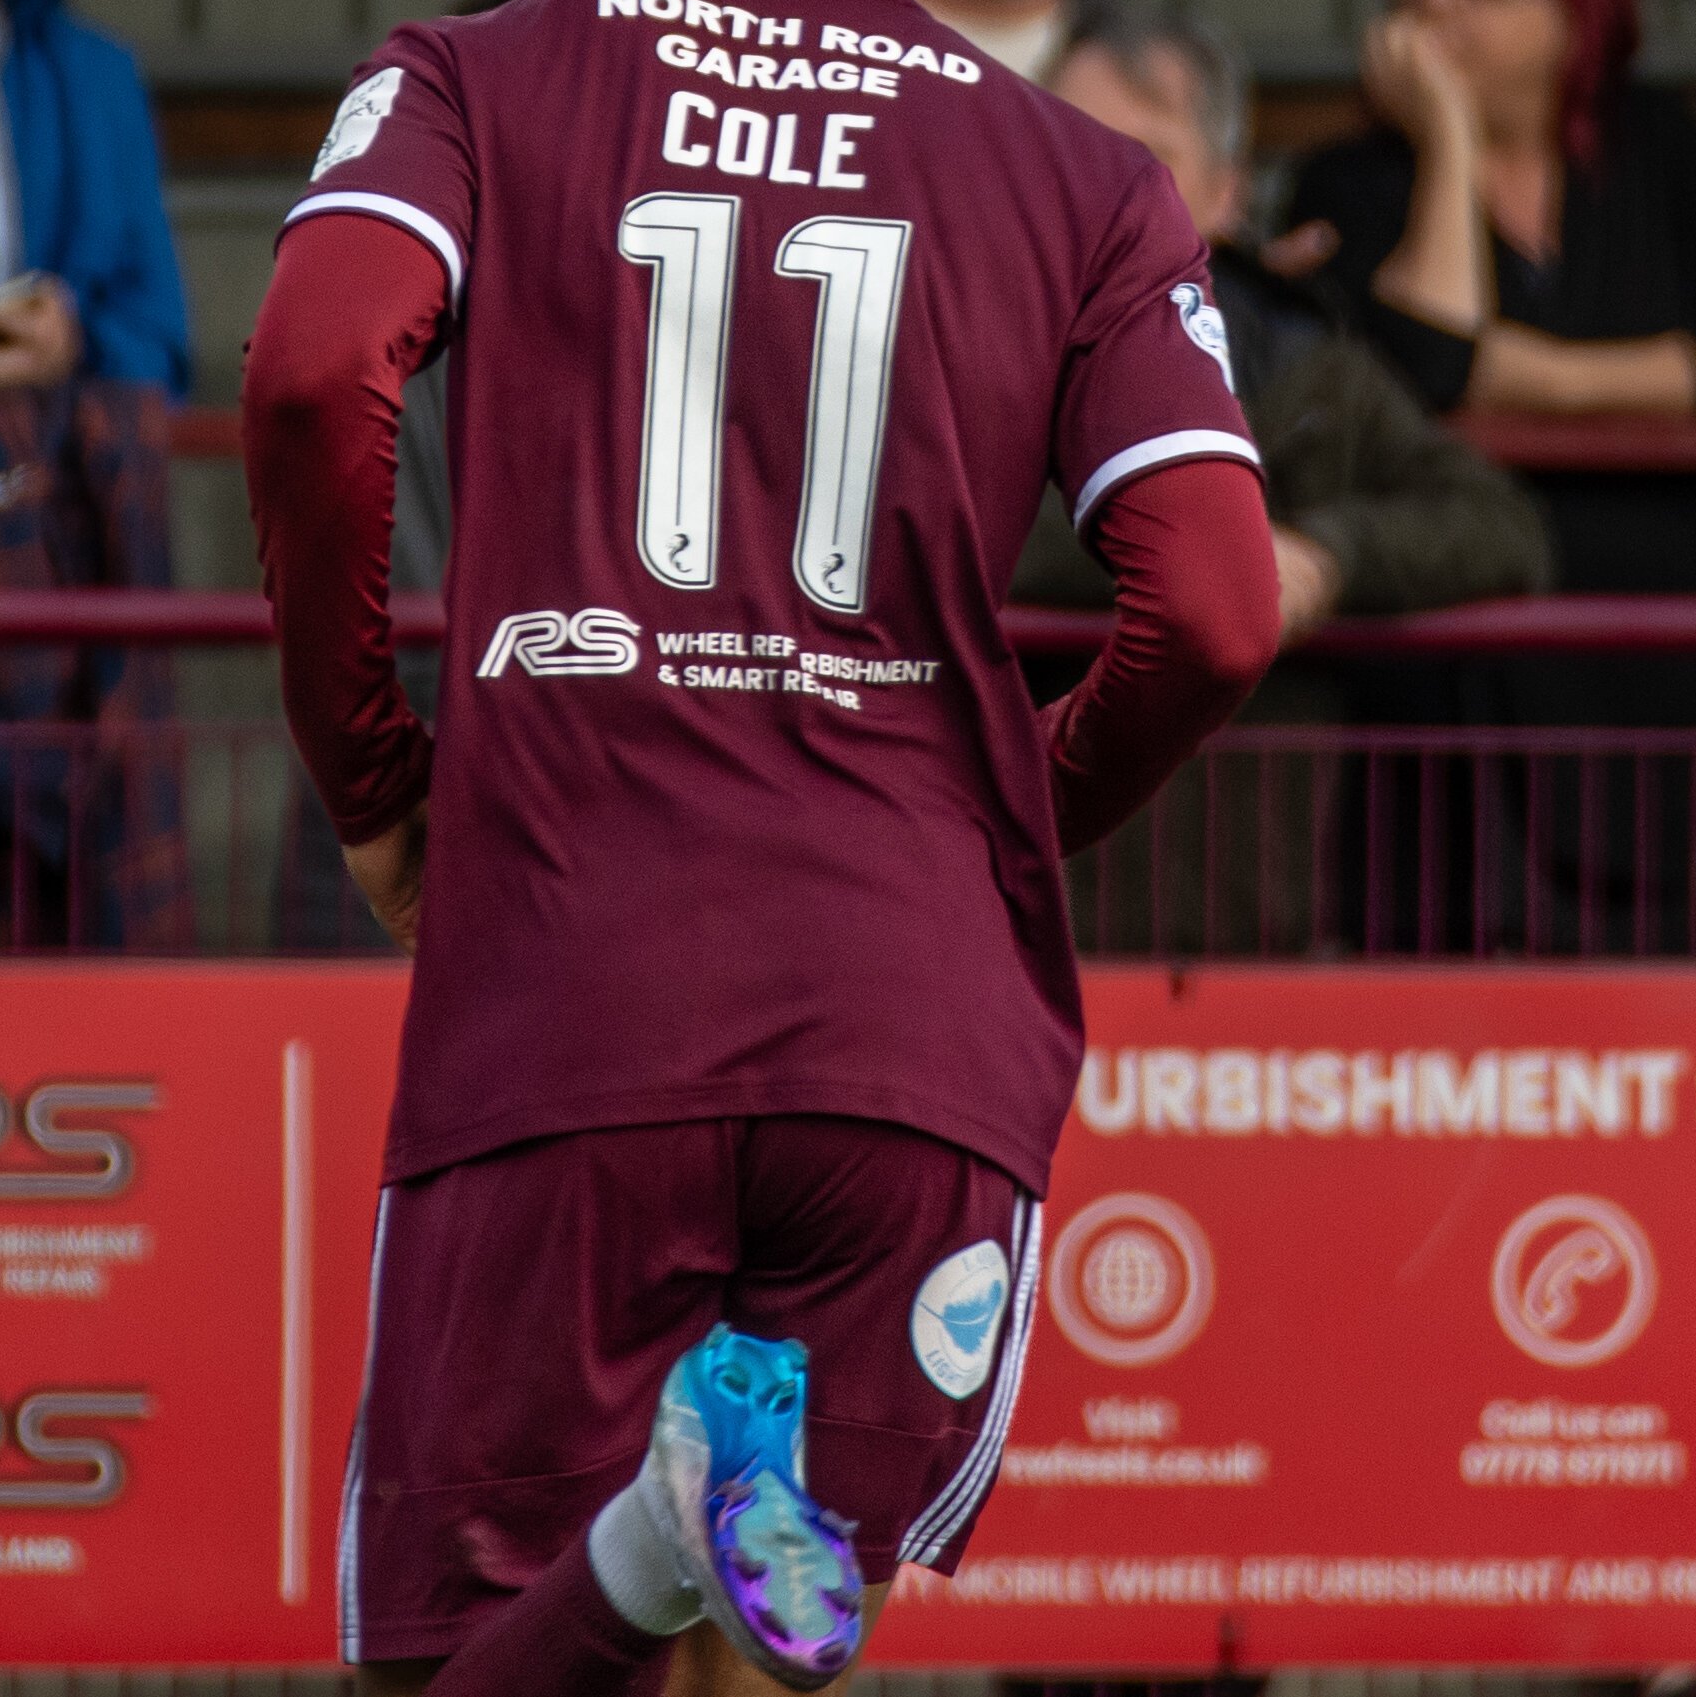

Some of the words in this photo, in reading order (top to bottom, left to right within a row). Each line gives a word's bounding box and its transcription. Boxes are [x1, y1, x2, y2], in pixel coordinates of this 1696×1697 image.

[655, 33, 901, 98] GARAGE
[819, 24, 982, 84] ROAD
[661, 90, 876, 189] COLE
[618, 191, 912, 614] 11
[476, 607, 642, 678] RS
[656, 633, 747, 656] WHEEL
[752, 635, 941, 684] REFRBISHMENT
[657, 664, 679, 686] &
[684, 665, 778, 692] SMART
[783, 670, 862, 711] REAIR
[1079, 1048, 1689, 1136] URBISHMENT
[955, 1557, 1093, 1604] MOBILE
[1102, 1557, 1228, 1604] WHEEL
[1235, 1557, 1559, 1604] REFURBISHMENT
[1566, 1557, 1652, 1604] AND
